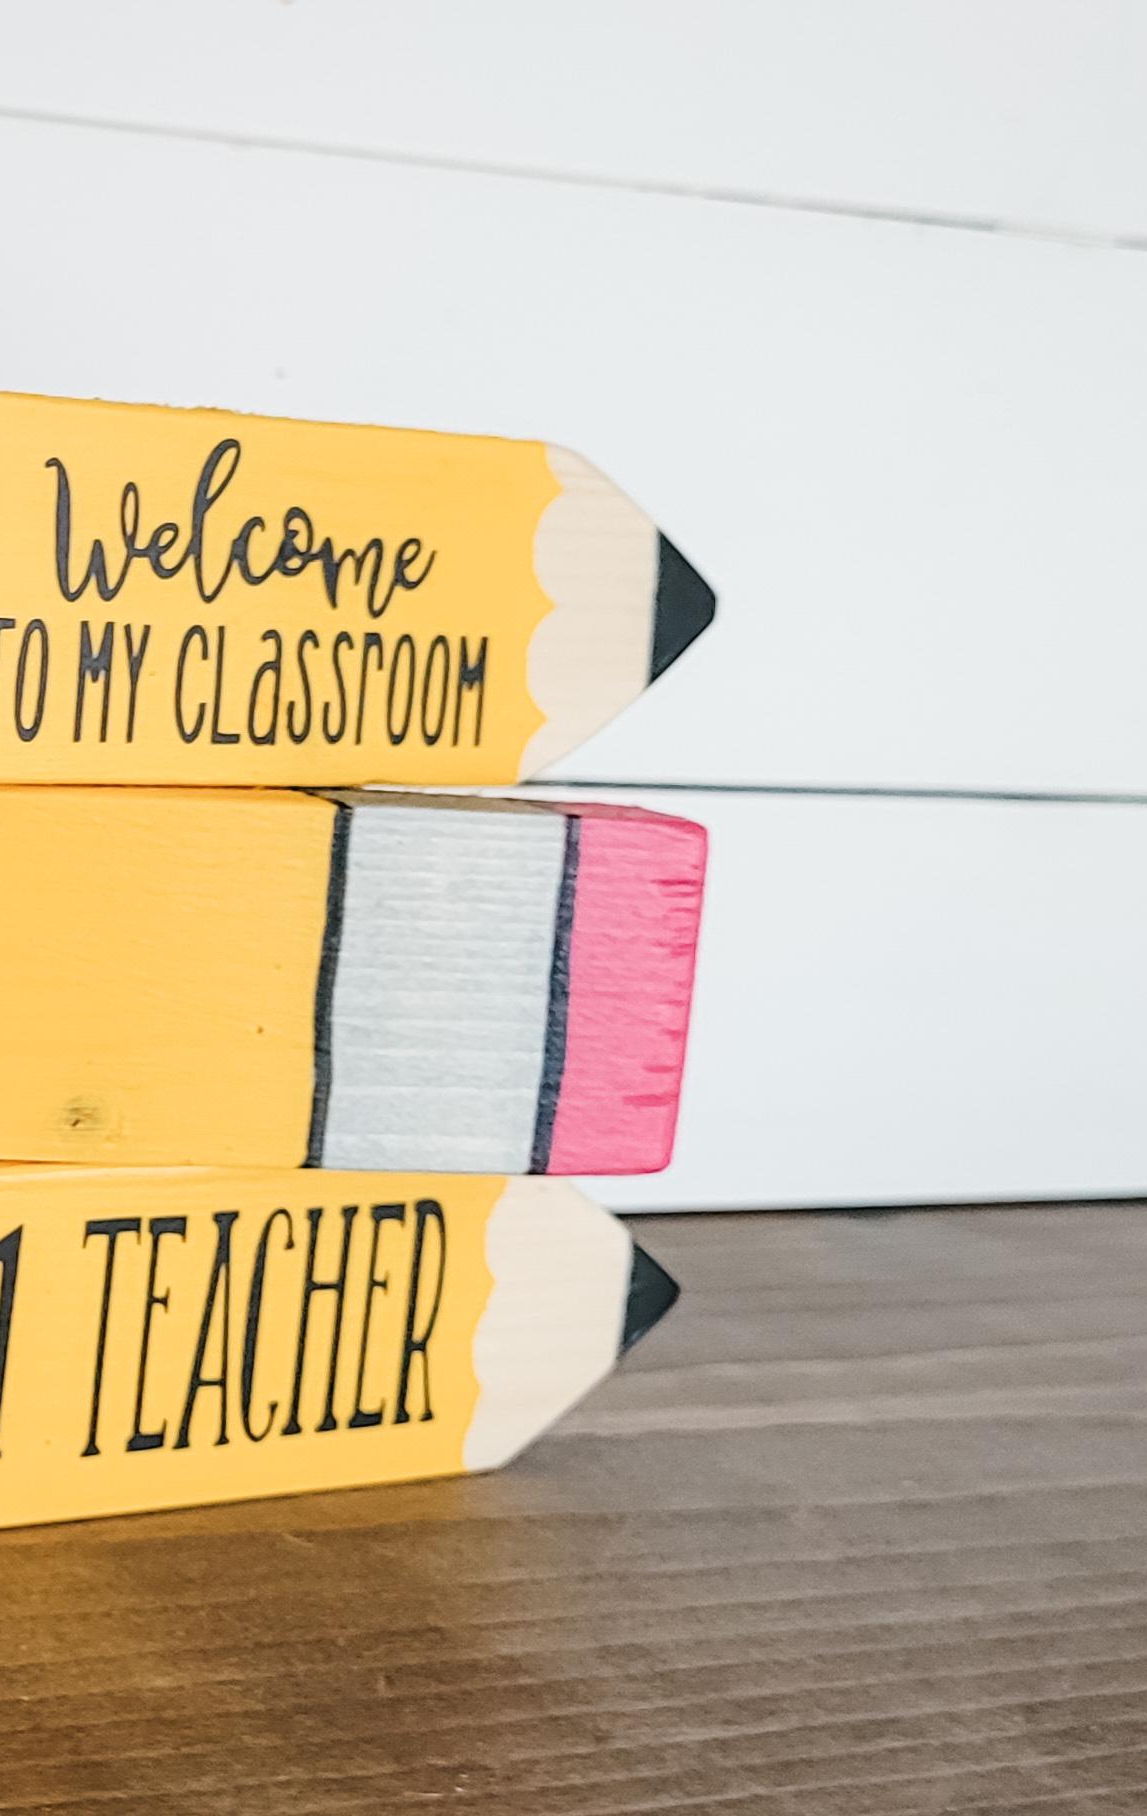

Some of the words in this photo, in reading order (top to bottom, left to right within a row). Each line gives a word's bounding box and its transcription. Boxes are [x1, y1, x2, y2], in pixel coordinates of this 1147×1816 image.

[45, 438, 436, 619] Welcome
[73, 620, 151, 743] MY
[81, 1198, 447, 1458] TEACHER
